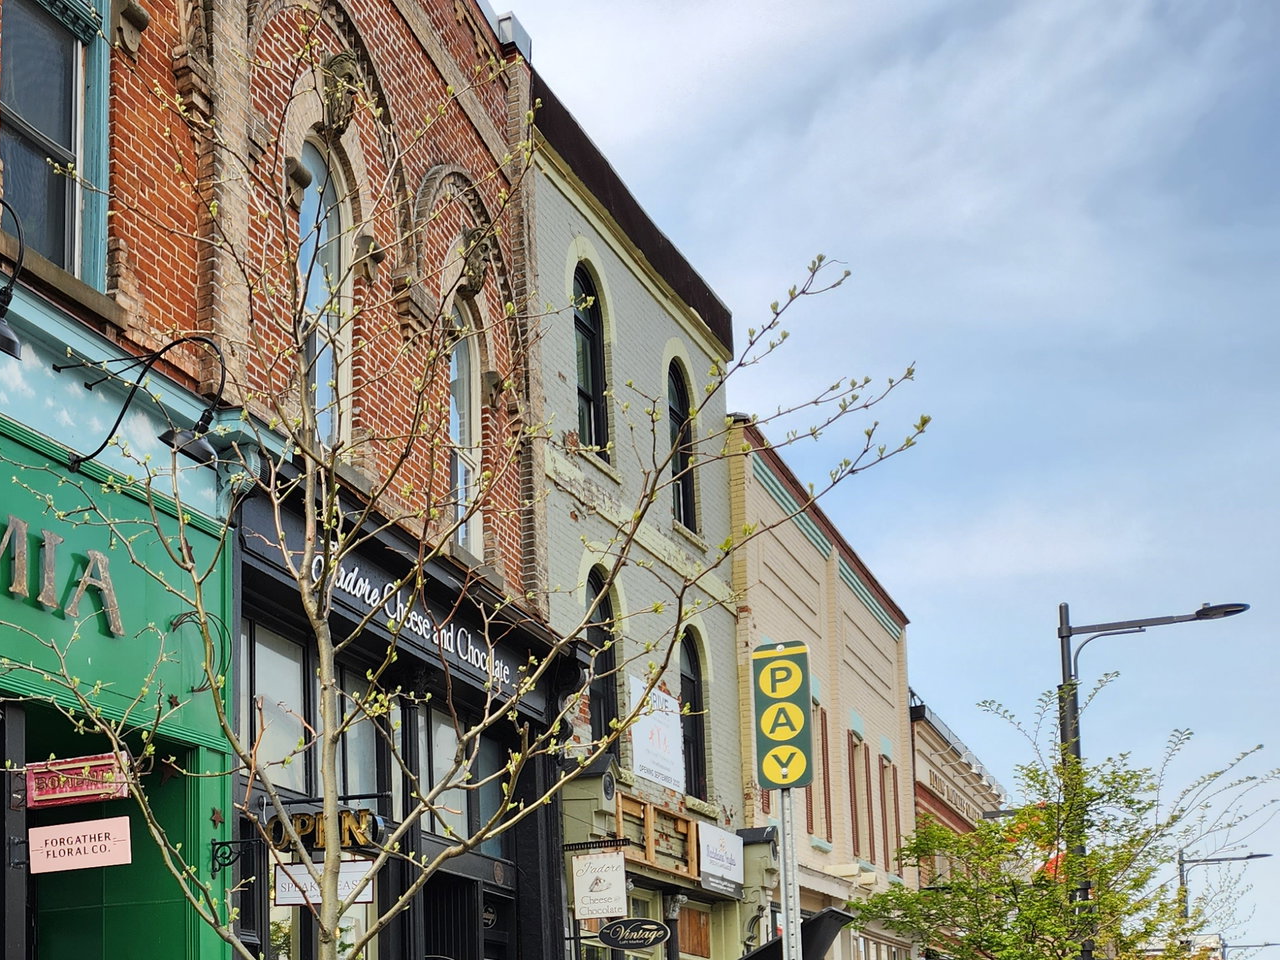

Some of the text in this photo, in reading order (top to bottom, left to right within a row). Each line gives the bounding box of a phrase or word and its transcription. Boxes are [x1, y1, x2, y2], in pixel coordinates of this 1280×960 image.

[383, 583, 431, 639] Cheese
[432, 623, 455, 653] and
[456, 627, 510, 684] Chocolate
[769, 666, 797, 779] PAY
[44, 832, 111, 848] FORGATHER
[46, 844, 111, 859] FLORAL CO.
[580, 896, 613, 905] Cheese
[579, 905, 623, 916] Chocolate
[610, 922, 664, 946] Vintage
